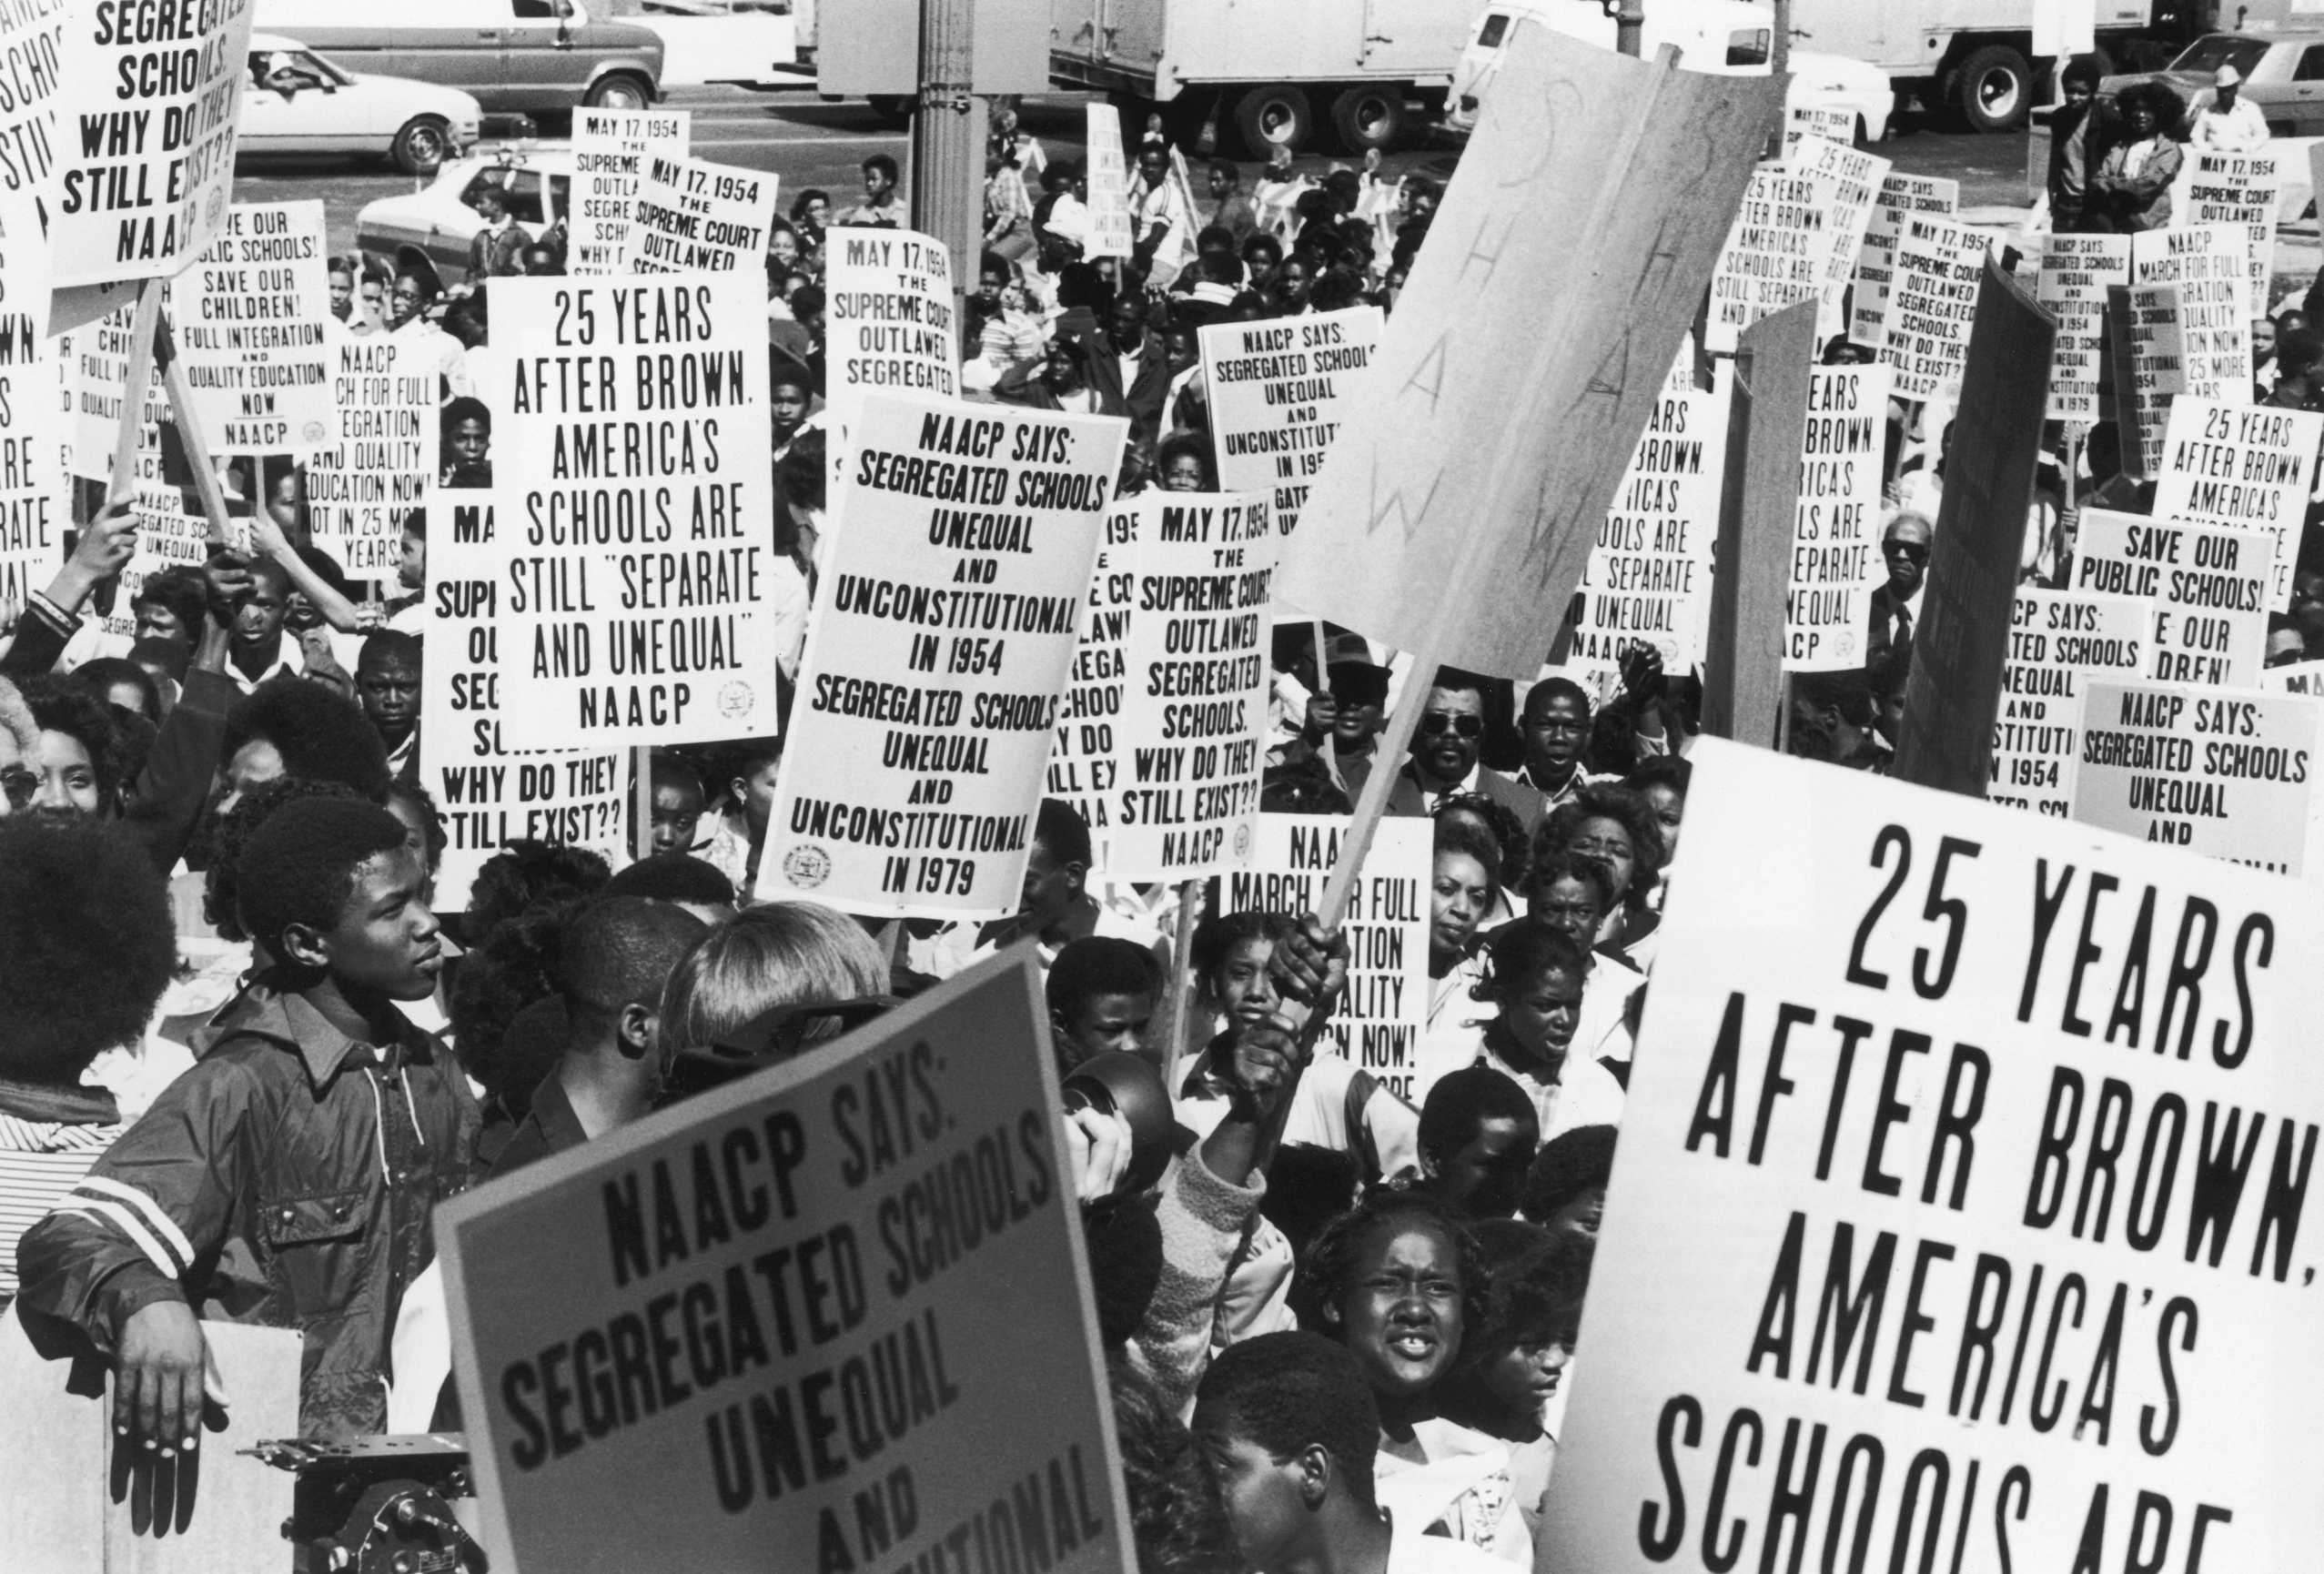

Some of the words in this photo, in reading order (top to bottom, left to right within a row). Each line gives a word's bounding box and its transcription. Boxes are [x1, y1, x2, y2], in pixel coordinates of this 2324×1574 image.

[80, 109, 150, 158] WHY
[163, 103, 197, 152] DO
[586, 116, 618, 136] MAY
[647, 119, 678, 137] 1954
[577, 154, 640, 175] SUPREME
[651, 158, 681, 188] MAY
[714, 175, 759, 204] 1954
[2199, 156, 2227, 173] MAY
[2251, 160, 2275, 175] 1954
[63, 164, 153, 214] STILL
[680, 195, 712, 215] THE
[1772, 180, 1813, 204] YEARS
[2190, 186, 2241, 204] SUPREME
[2245, 187, 2276, 205] COURT
[254, 212, 288, 235] OUR
[635, 200, 701, 240] SUPREME
[705, 220, 762, 251] COURT
[2201, 205, 2263, 222] OUTLAWED
[1911, 221, 1937, 242] MAY
[2167, 232, 2211, 256] NAACP
[241, 236, 318, 263] SCHOOLS!
[644, 233, 735, 271] OUTLAWED
[847, 239, 891, 267] MAY
[1899, 251, 1951, 276] SUPREME
[2084, 257, 2125, 270] SCHOOLS
[204, 270, 248, 293] SAVE
[259, 268, 295, 291] OUR
[898, 275, 927, 291] THE
[1726, 251, 1784, 280] SCHOOLS
[1791, 260, 1815, 283] ARE
[2139, 260, 2181, 284] MARCH
[2186, 257, 2207, 279] FOR
[2213, 255, 2242, 277] FULL
[1716, 277, 1748, 301] STILL
[1907, 275, 1975, 302] OUTLAWED
[202, 295, 301, 320] CHILDREN!
[555, 288, 595, 347] 25
[613, 285, 712, 345] YEARS
[834, 293, 923, 323] SUPREME
[1897, 291, 1975, 321] SEGREGATED
[185, 327, 221, 349] FULL
[227, 323, 325, 348] INTEGRATION
[859, 326, 946, 362] OUTLAWED
[1243, 328, 1294, 354] NAACP
[1888, 329, 1912, 350] WHY
[1915, 338, 1935, 356] DO
[241, 353, 268, 362] AND
[341, 345, 396, 373] NAACP
[1217, 354, 1307, 382] SEGREGATED
[1879, 348, 1910, 371] STILL
[2189, 359, 2206, 380] 25
[2212, 356, 2247, 378] MORE
[189, 365, 243, 388] QUALITY
[250, 362, 326, 388] EDUCATION
[363, 378, 389, 405] FOR
[398, 377, 431, 405] FULL
[514, 356, 616, 414] AFTER
[847, 358, 953, 396] SEGREGATED
[1265, 378, 1336, 405] UNEQUAL
[1895, 374, 1937, 396] NAACP
[241, 392, 275, 416] NOW
[1288, 406, 1317, 423] AND
[226, 423, 288, 445] NAACP
[919, 412, 1005, 459] NAACP
[1012, 424, 1076, 465] SAYS:
[2205, 408, 2231, 439] 25
[2239, 412, 2293, 448] YEARS
[355, 441, 421, 469] QUALITY
[552, 418, 719, 479] AMERICA'S
[2174, 440, 2236, 479] AFTER
[858, 449, 1008, 506] SEGREGATED
[1015, 470, 1107, 512] SCHOOLS
[138, 491, 180, 512] NAACP
[526, 487, 672, 546] SCHOOLS
[692, 482, 744, 540] ARE
[362, 508, 381, 536] 25
[929, 508, 1033, 553] UNEQUAL
[1160, 507, 1213, 542] MAY
[1246, 502, 1268, 540] 1954
[1653, 520, 1690, 553] ARE
[1830, 503, 1864, 539] ARE
[147, 537, 203, 561] UNEQUAL
[1214, 549, 1244, 568] THE
[2125, 525, 2183, 564] SAVE
[2195, 535, 2238, 571] OUR
[510, 556, 595, 612] STILL
[953, 558, 998, 584] AND
[2079, 556, 2159, 598] PUBLIC
[2168, 570, 2265, 613] SCHOOLS!
[835, 574, 1076, 634] UNCONSTITUTIONAL
[1140, 575, 1236, 611] SUPREME
[1238, 568, 1272, 609] COURT
[1166, 613, 1258, 654] OUTLAWED
[2047, 602, 2103, 632] SAYS:
[2183, 616, 2230, 652] OUR
[533, 622, 591, 679] AND
[909, 633, 939, 672] IN
[947, 636, 1005, 675] 1954
[2055, 636, 2138, 668] SCHOOLS
[1147, 654, 1261, 696] SEGREGATED
[579, 683, 691, 729] NAACP
[812, 673, 962, 727] SEGREGATED
[971, 692, 1058, 732] SCHOOLS
[1163, 699, 1248, 739] SCHOOLS.
[2006, 700, 2046, 721] AND
[2120, 691, 2184, 730] NAACP
[2195, 699, 2263, 738] SAYS:
[883, 731, 989, 774] UNEQUAL
[1136, 747, 1185, 782] WHY
[1192, 745, 1218, 781] DO
[1224, 737, 1258, 777] THEY
[2083, 730, 2194, 773] SEGREGATED
[2203, 742, 2309, 784] SCHOOLS
[441, 765, 506, 803] WHY
[519, 763, 555, 802] DO
[566, 754, 617, 798] THEY
[2011, 759, 2059, 789] 1954
[908, 780, 953, 804] AND
[1120, 789, 1185, 824] STILL
[1194, 779, 1258, 822] EXIST??
[2129, 775, 2228, 819] UNEQUAL
[791, 796, 1028, 853] UNCONSTITUTIONAL
[2147, 819, 2193, 846] AND
[1162, 826, 1223, 867] NAACP
[882, 856, 910, 893] IN
[915, 856, 975, 895] 1979
[1231, 872, 1310, 918] MARCH
[1372, 877, 1420, 922] FULL
[1845, 823, 1982, 1001] 25
[2016, 856, 2275, 1071] YEARS
[1362, 1024, 1416, 1068] NOW!
[1684, 991, 1992, 1213] AFTER
[2023, 1064, 2319, 1288] BROWN,
[602, 1110, 806, 1286] NAACP
[831, 1038, 955, 1188] SAYS:
[500, 1221, 867, 1472] SEGREGATED
[877, 1108, 1053, 1299] SCHOOLS
[1747, 1210, 2200, 1458] AMERICA'S
[704, 1307, 960, 1516] UNEQUAL
[1639, 1394, 2031, 1574] SCHOOLS
[819, 1465, 919, 1573] AND
